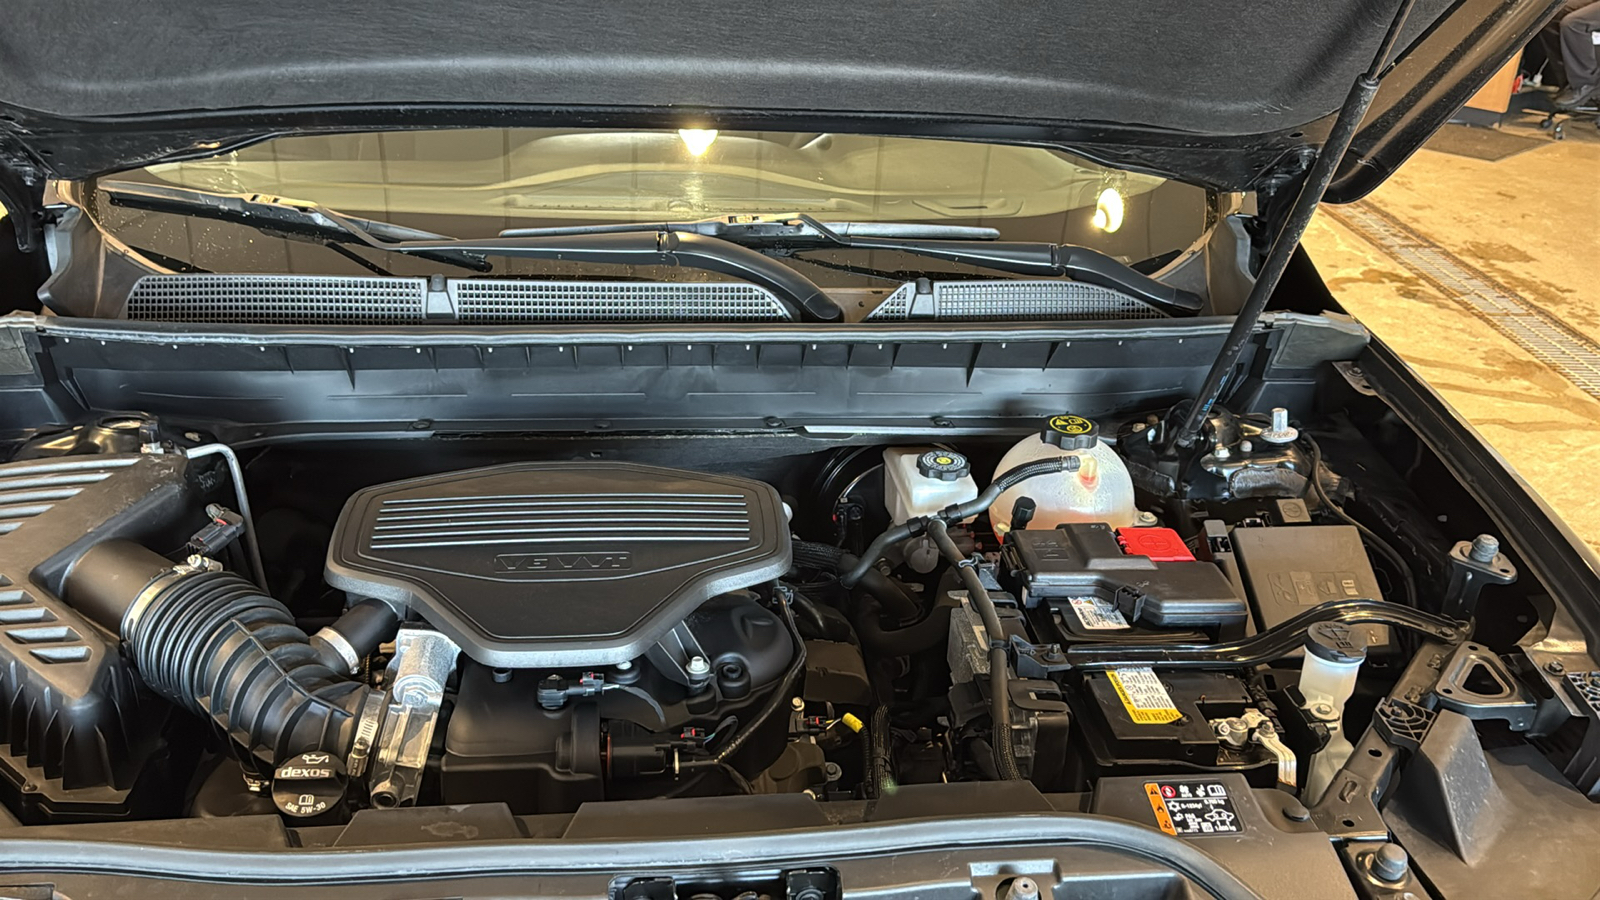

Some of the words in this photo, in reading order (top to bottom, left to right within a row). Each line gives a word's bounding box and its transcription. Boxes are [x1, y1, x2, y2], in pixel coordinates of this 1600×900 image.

[281, 767, 332, 778] dexos
[285, 802, 299, 813] SAE
[301, 802, 326, 814] 5W-30
